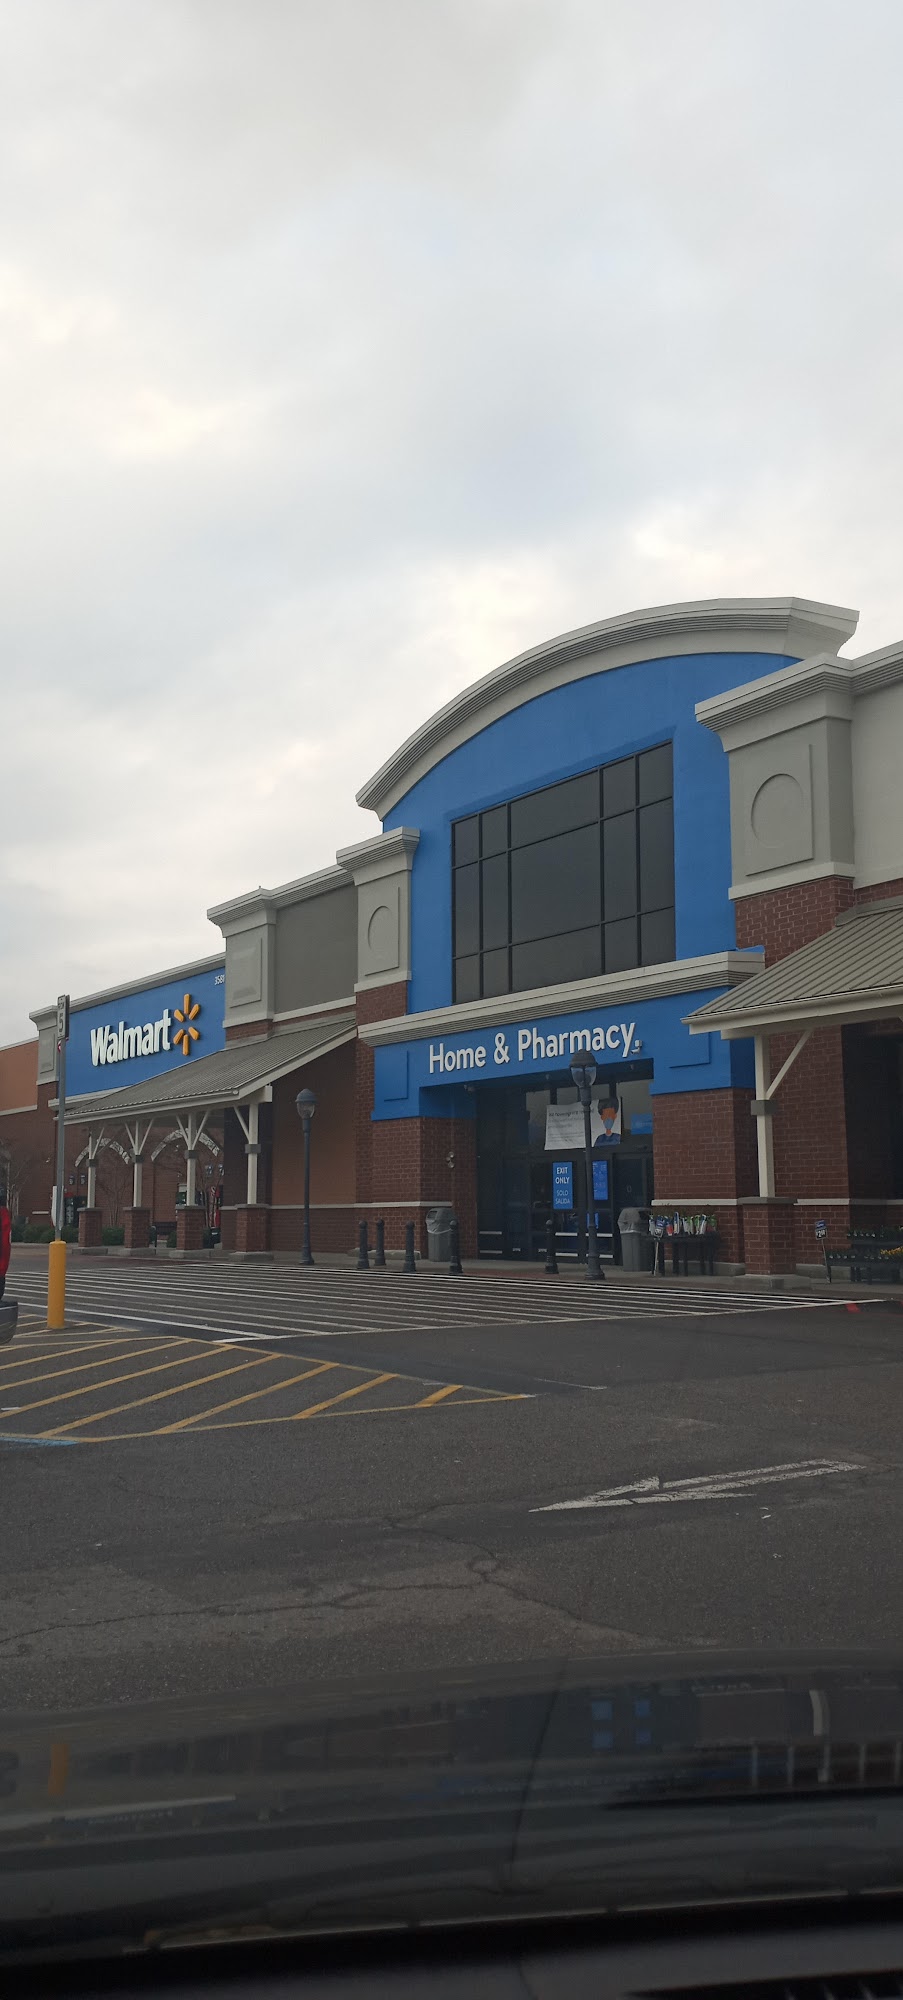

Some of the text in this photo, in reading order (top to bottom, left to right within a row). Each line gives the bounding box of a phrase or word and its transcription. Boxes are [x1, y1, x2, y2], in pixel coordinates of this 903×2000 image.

[91, 1009, 171, 1066] Walmart
[429, 1022, 635, 1073] Home & Pharmacy
